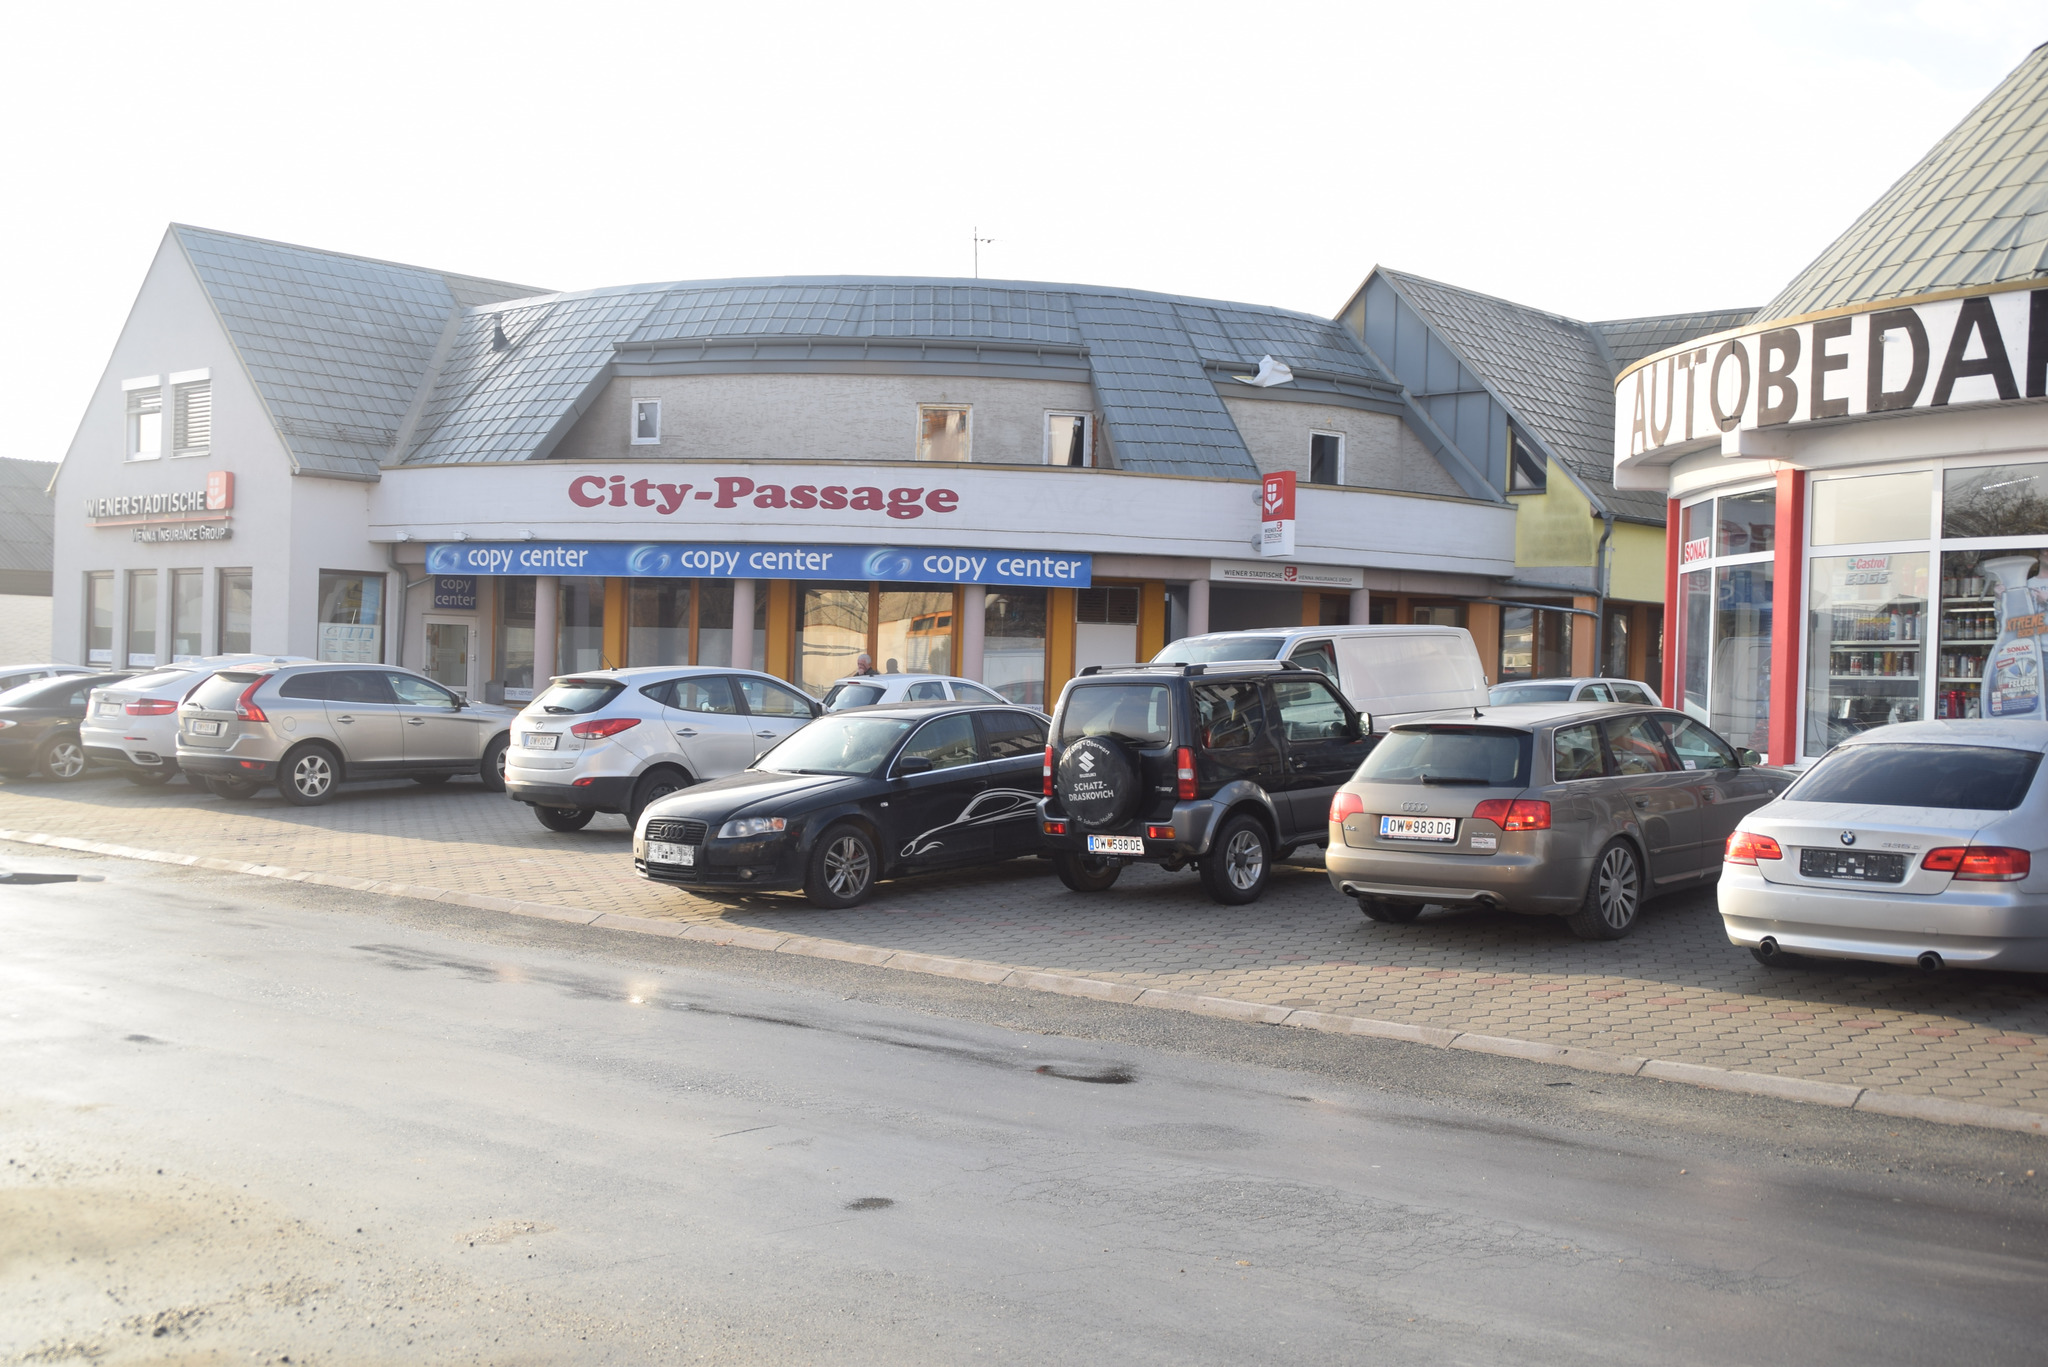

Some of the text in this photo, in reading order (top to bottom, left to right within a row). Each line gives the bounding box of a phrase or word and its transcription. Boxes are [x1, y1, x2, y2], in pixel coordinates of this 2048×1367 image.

[568, 475, 959, 520] City-Passage
[84, 496, 130, 518] WIENER
[1685, 539, 1708, 562] SONAX
[468, 546, 588, 572] copy center
[681, 549, 833, 575] copy center
[1856, 557, 1886, 569] Castrol
[923, 555, 1082, 581] copy center
[1224, 569, 1248, 577] WIENER
[1845, 572, 1889, 585] EDGE
[441, 579, 471, 593] copy
[435, 594, 476, 606] center
[2007, 645, 2030, 653] SONAX
[2008, 676, 2036, 688] FELGEN
[1074, 781, 1107, 791] SCHATZ-
[1068, 790, 1114, 801] DRASKOVICH
[1389, 821, 1451, 835] OW 983 DG
[1094, 838, 1141, 851] OW 598 DE
